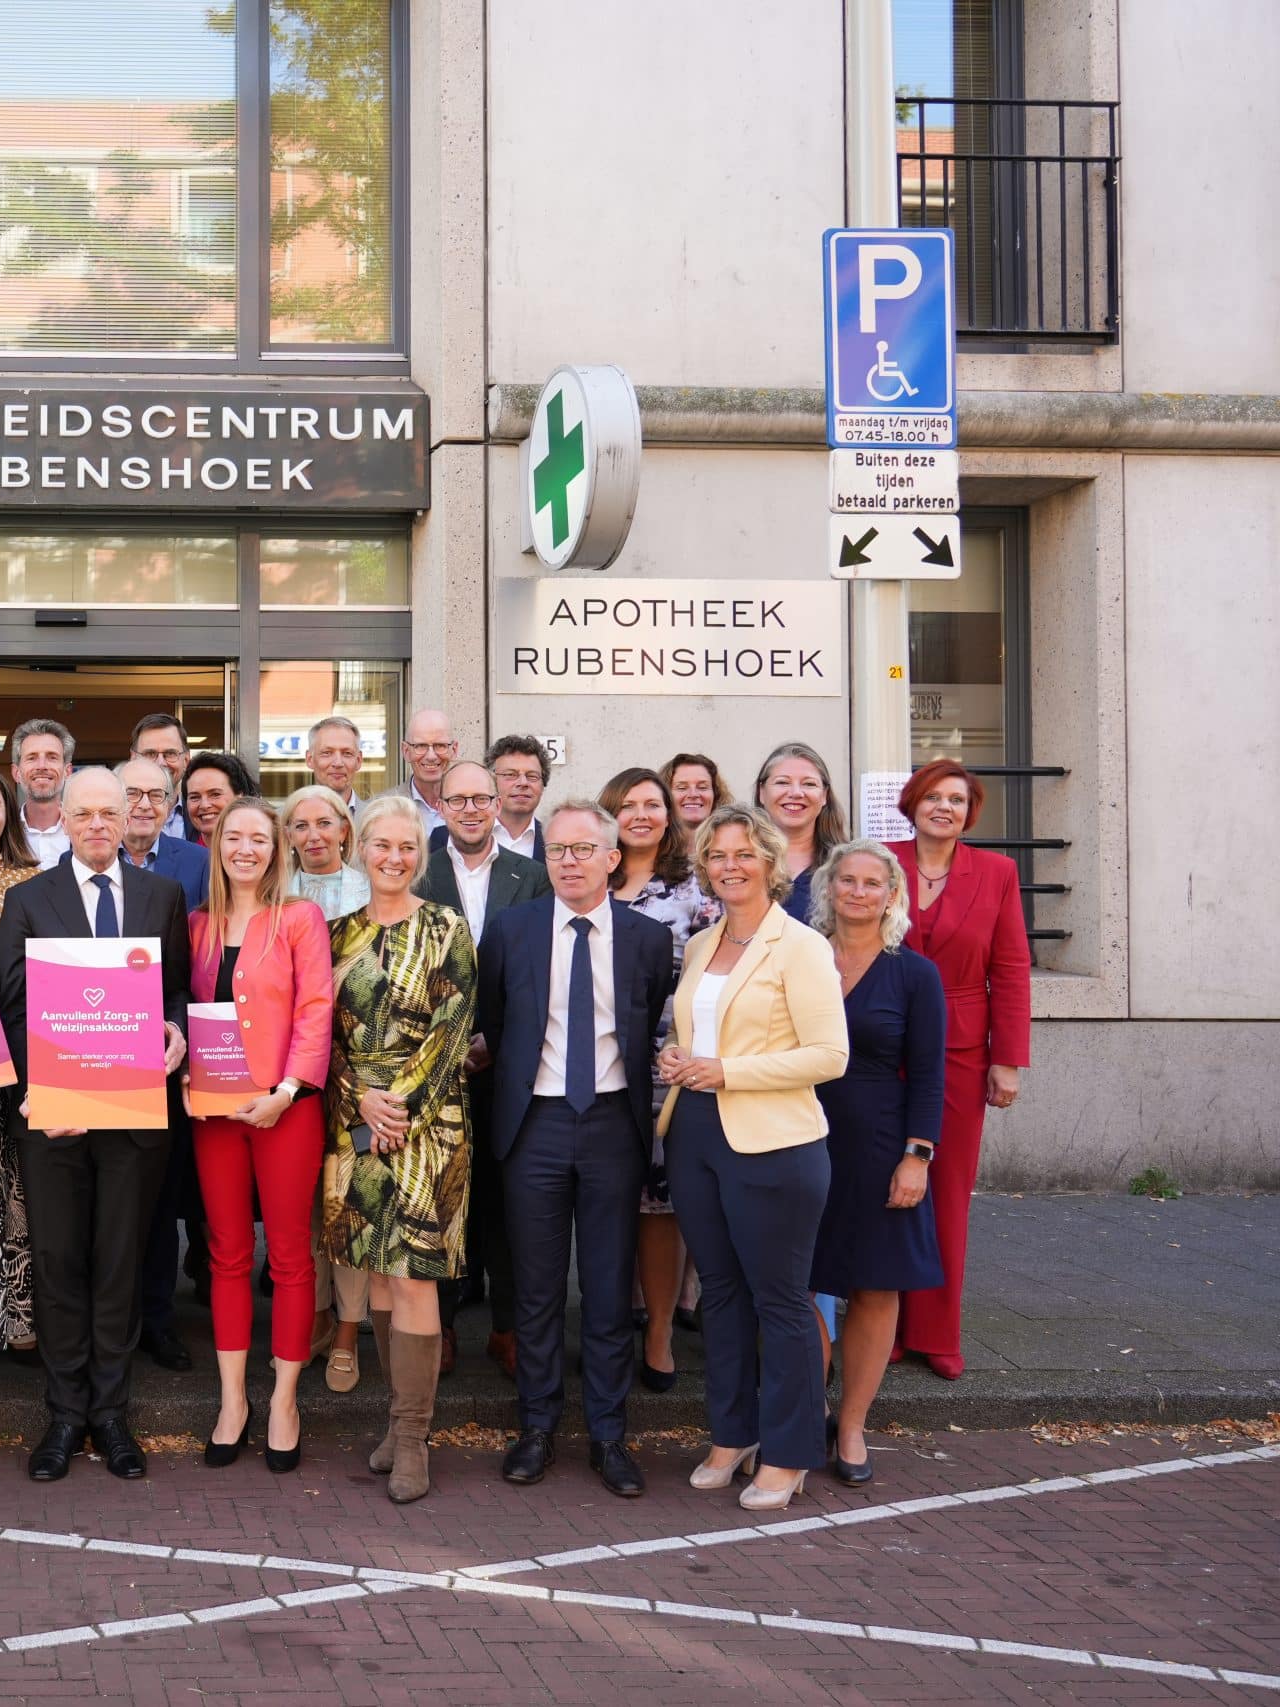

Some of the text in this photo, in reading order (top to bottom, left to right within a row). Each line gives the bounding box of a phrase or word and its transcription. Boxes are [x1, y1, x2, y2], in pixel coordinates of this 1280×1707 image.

[858, 244, 922, 333] P
[839, 416, 948, 430] maandag t/m vrijdag
[845, 430, 939, 442] 07.45-18.00 h
[855, 452, 936, 467] Buiten deze
[876, 474, 914, 491] tijden
[837, 494, 954, 510] betaald parkeren
[549, 598, 786, 628] APOTHEEK
[513, 647, 824, 677] RUBENSHOEK
[889, 666, 902, 678] 21
[41, 1011, 101, 1020] Aanvullend
[104, 1011, 133, 1022] Zorg-
[51, 1023, 139, 1034] Welzijnsakkoord
[120, 1054, 135, 1062] zorg
[91, 1061, 111, 1070] welzijn
